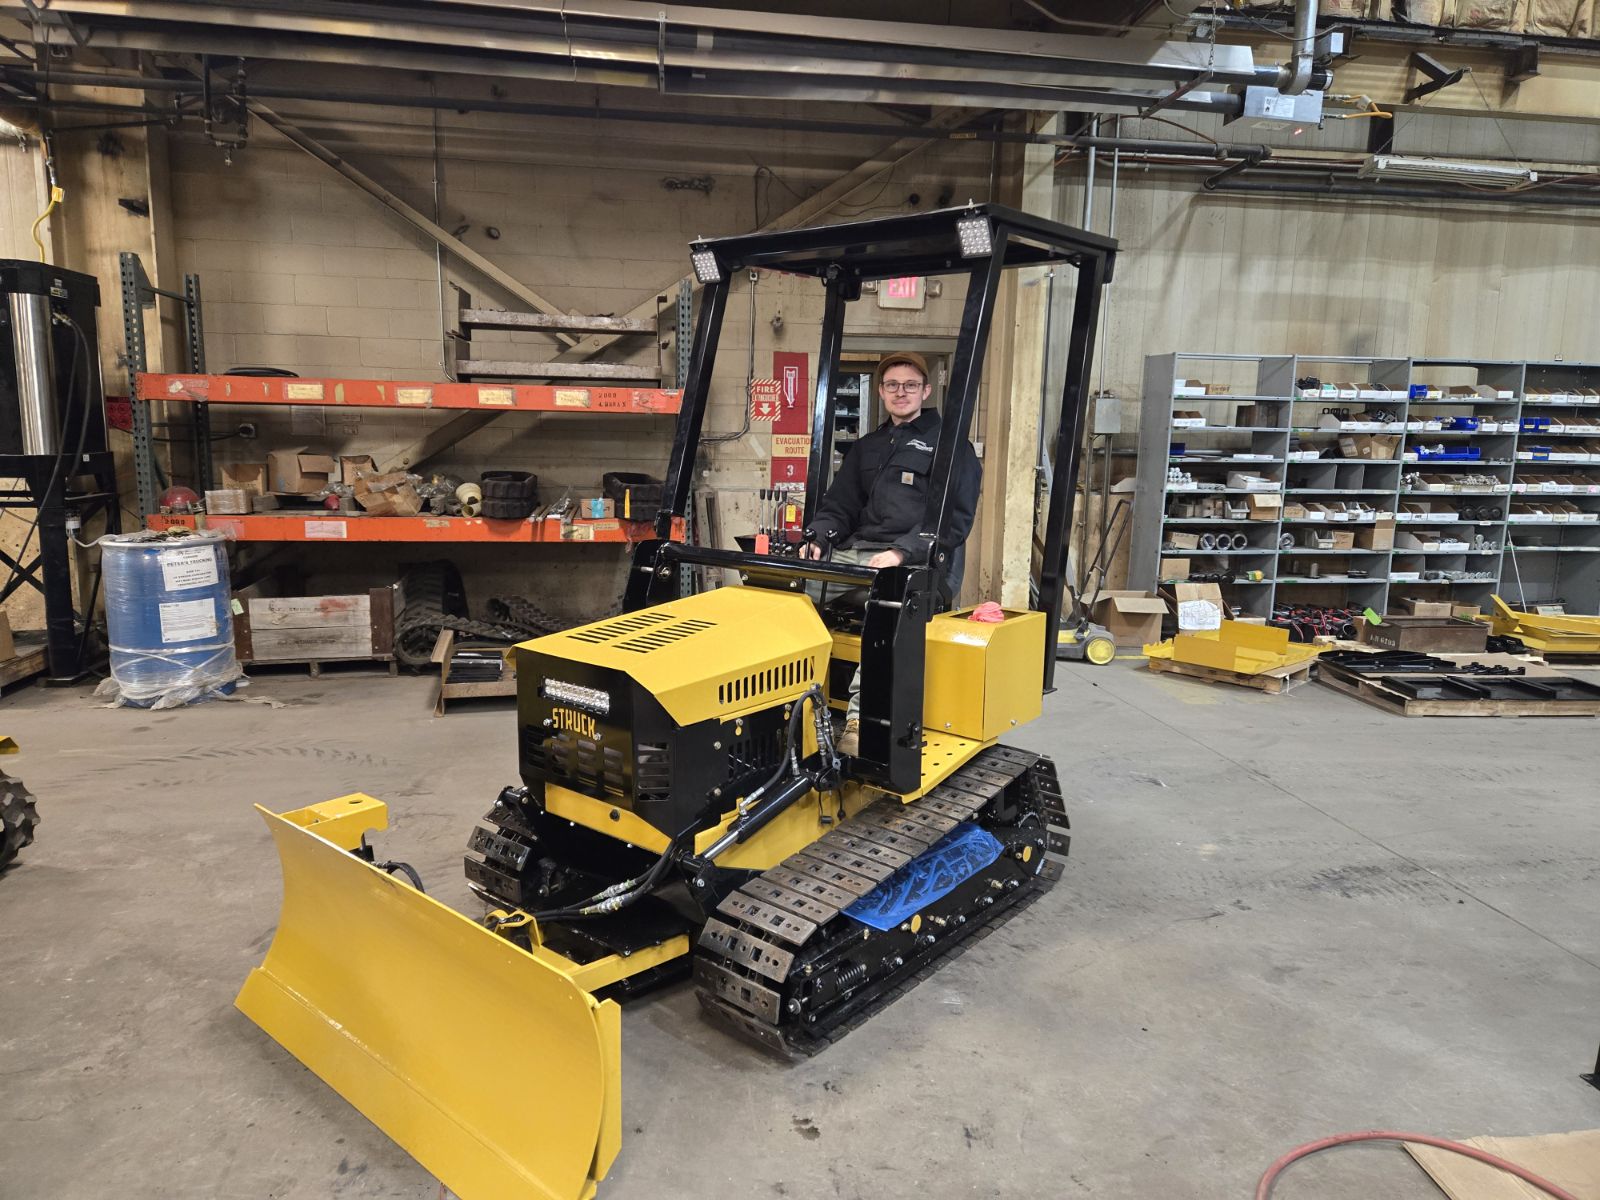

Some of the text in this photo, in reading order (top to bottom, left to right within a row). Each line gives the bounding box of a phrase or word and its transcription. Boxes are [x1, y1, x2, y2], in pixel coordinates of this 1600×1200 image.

[888, 277, 917, 298] EXIT
[756, 385, 775, 393] FIRE
[775, 437, 811, 445] EVACUATIO
[784, 446, 805, 454] ROUTE
[786, 464, 795, 477] 3
[552, 707, 596, 740] STRUCK
